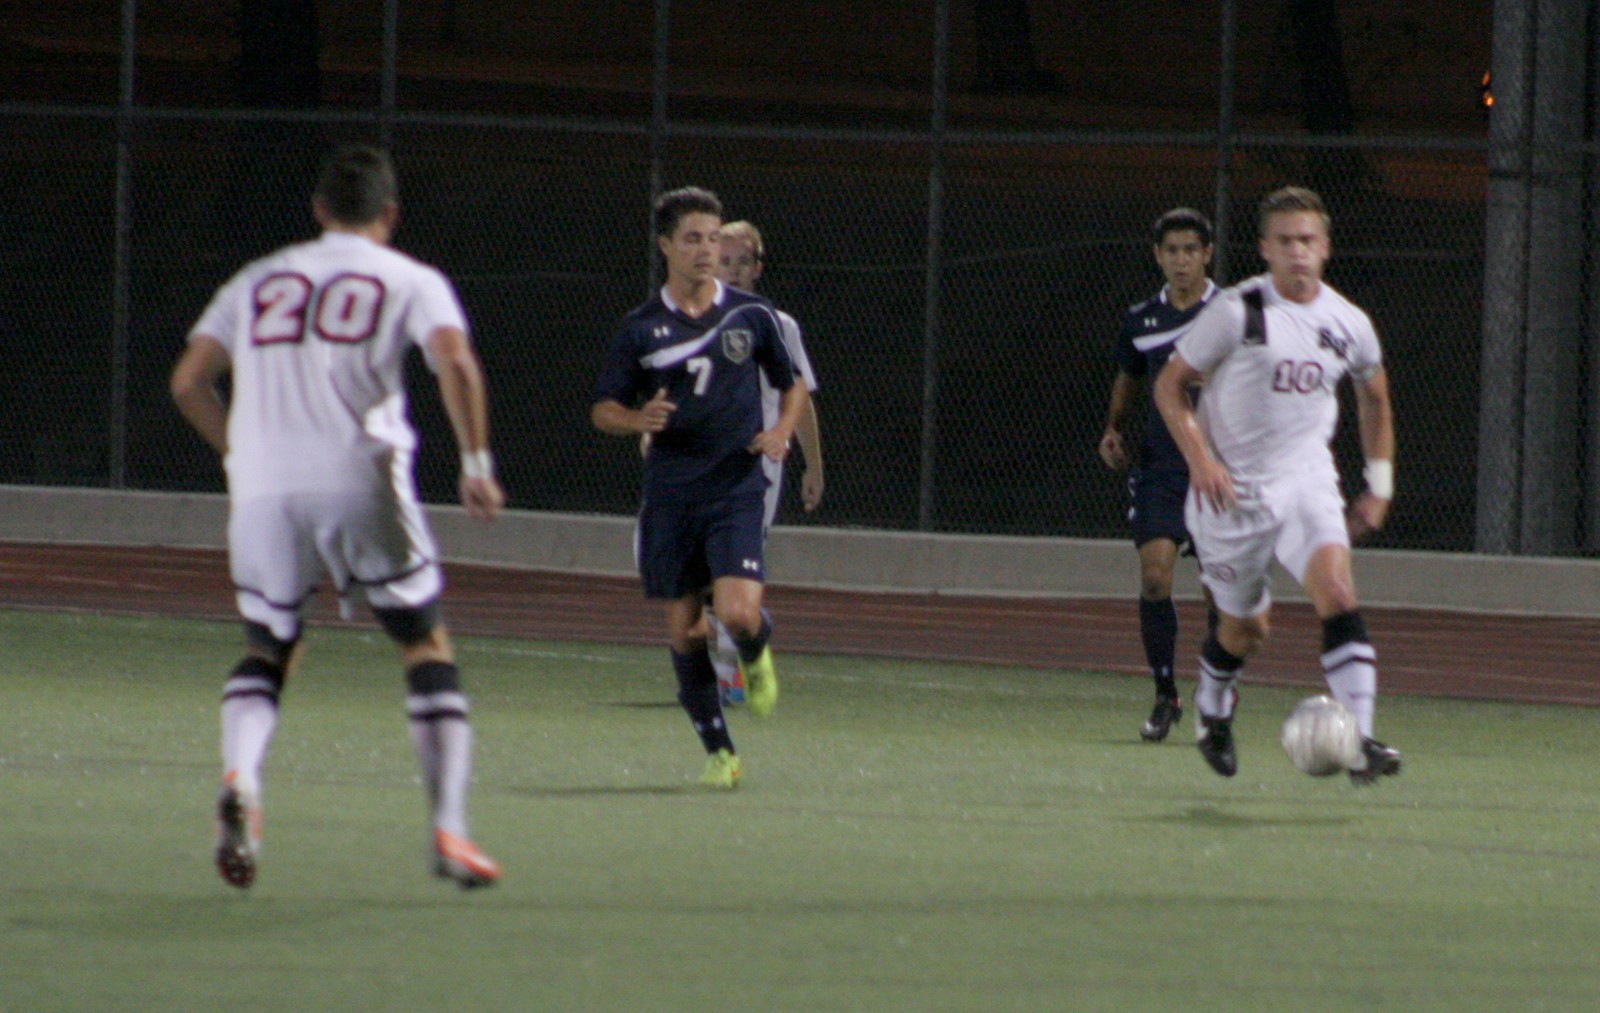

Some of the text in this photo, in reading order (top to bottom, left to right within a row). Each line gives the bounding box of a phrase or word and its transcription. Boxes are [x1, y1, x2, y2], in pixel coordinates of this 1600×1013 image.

[253, 271, 386, 345] 20
[686, 356, 712, 396] 7
[1271, 359, 1324, 394] 10
